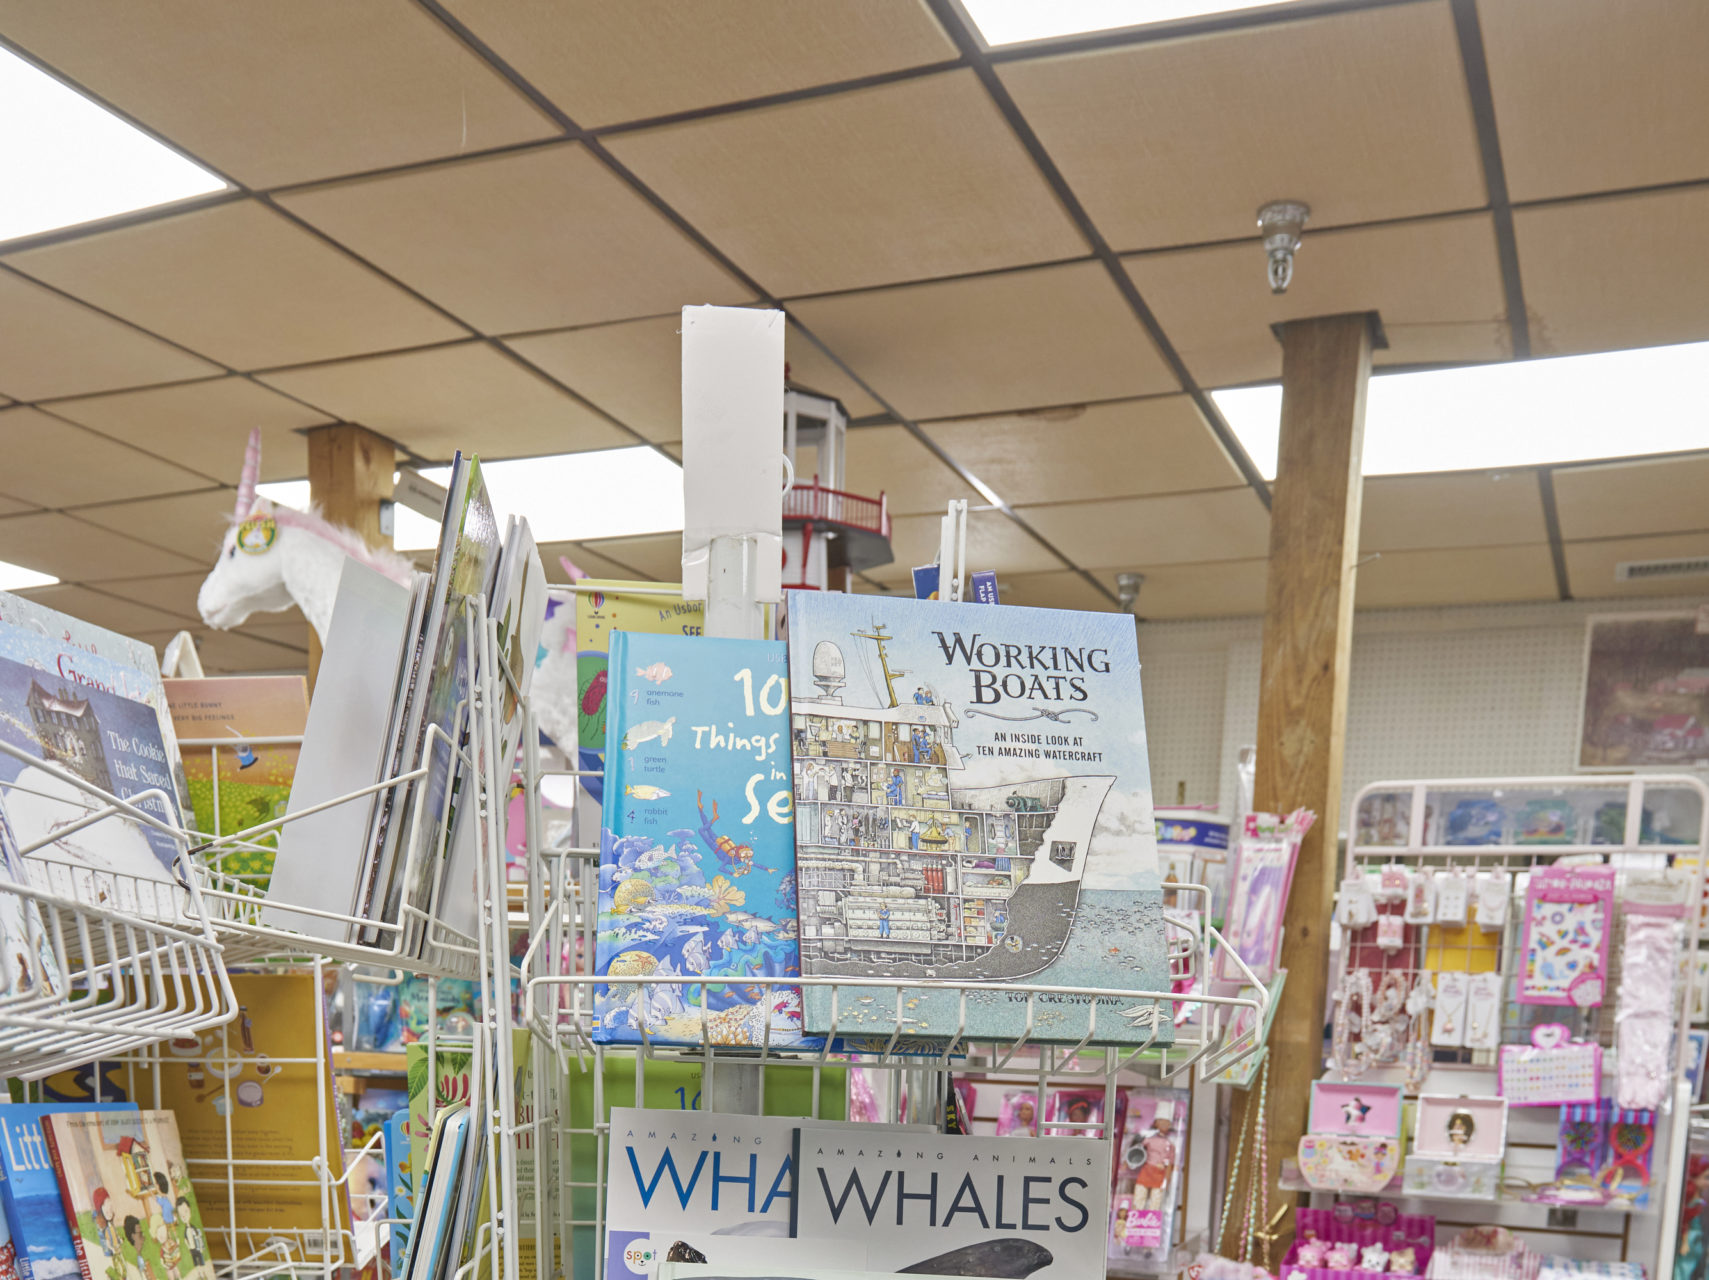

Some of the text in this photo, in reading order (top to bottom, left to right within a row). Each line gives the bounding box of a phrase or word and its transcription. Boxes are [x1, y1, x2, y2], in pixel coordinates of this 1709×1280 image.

[659, 610, 672, 621] An
[646, 689, 684, 698] anemone
[646, 698, 660, 706] fish
[107, 730, 165, 764] The Cookie
[691, 722, 779, 761] Things
[994, 732, 1083, 747] AN INSIDE LOOK AT
[644, 756, 667, 764] green
[977, 745, 1103, 762] TEN AMAZING WATERCRAFT
[114, 759, 172, 791] that Saved
[644, 765, 666, 773] turtle
[770, 761, 787, 780] in
[644, 807, 668, 816] rabbit
[644, 817, 658, 825] fish
[973, 1154, 1092, 1165] ANIMALS
[625, 1146, 792, 1213] WHA
[817, 1166, 1089, 1233] WHALES
[626, 1249, 656, 1264] spot
